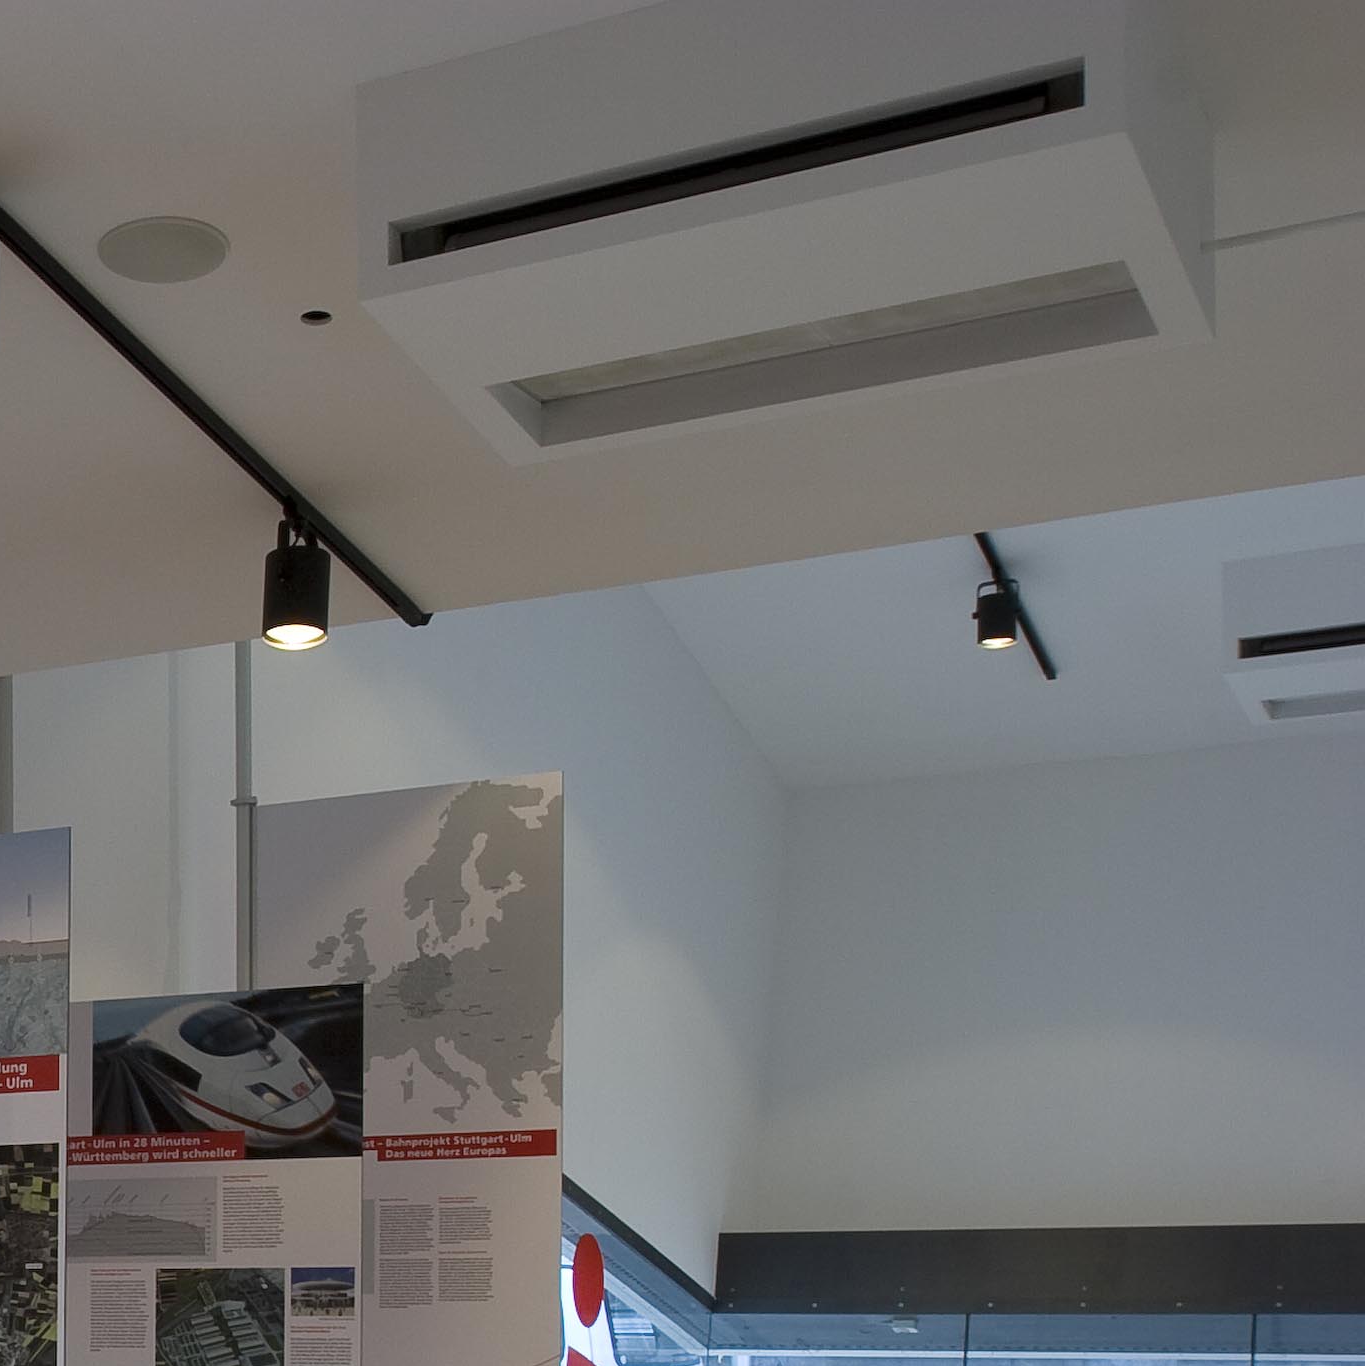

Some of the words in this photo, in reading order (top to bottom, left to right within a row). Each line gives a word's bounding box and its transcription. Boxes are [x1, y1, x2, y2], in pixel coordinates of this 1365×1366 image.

[6, 1076, 34, 1090] Ulm
[119, 1138, 130, 1148] in
[133, 1137, 148, 1148] 28
[150, 1136, 201, 1148] Minuten
[385, 1136, 450, 1148] Bahnprojekt
[152, 1149, 180, 1160] wird
[182, 1147, 238, 1159] schneller
[385, 1149, 405, 1158] Das
[407, 1150, 434, 1158] neue
[436, 1147, 461, 1156] Herz
[463, 1147, 507, 1157] Europas
